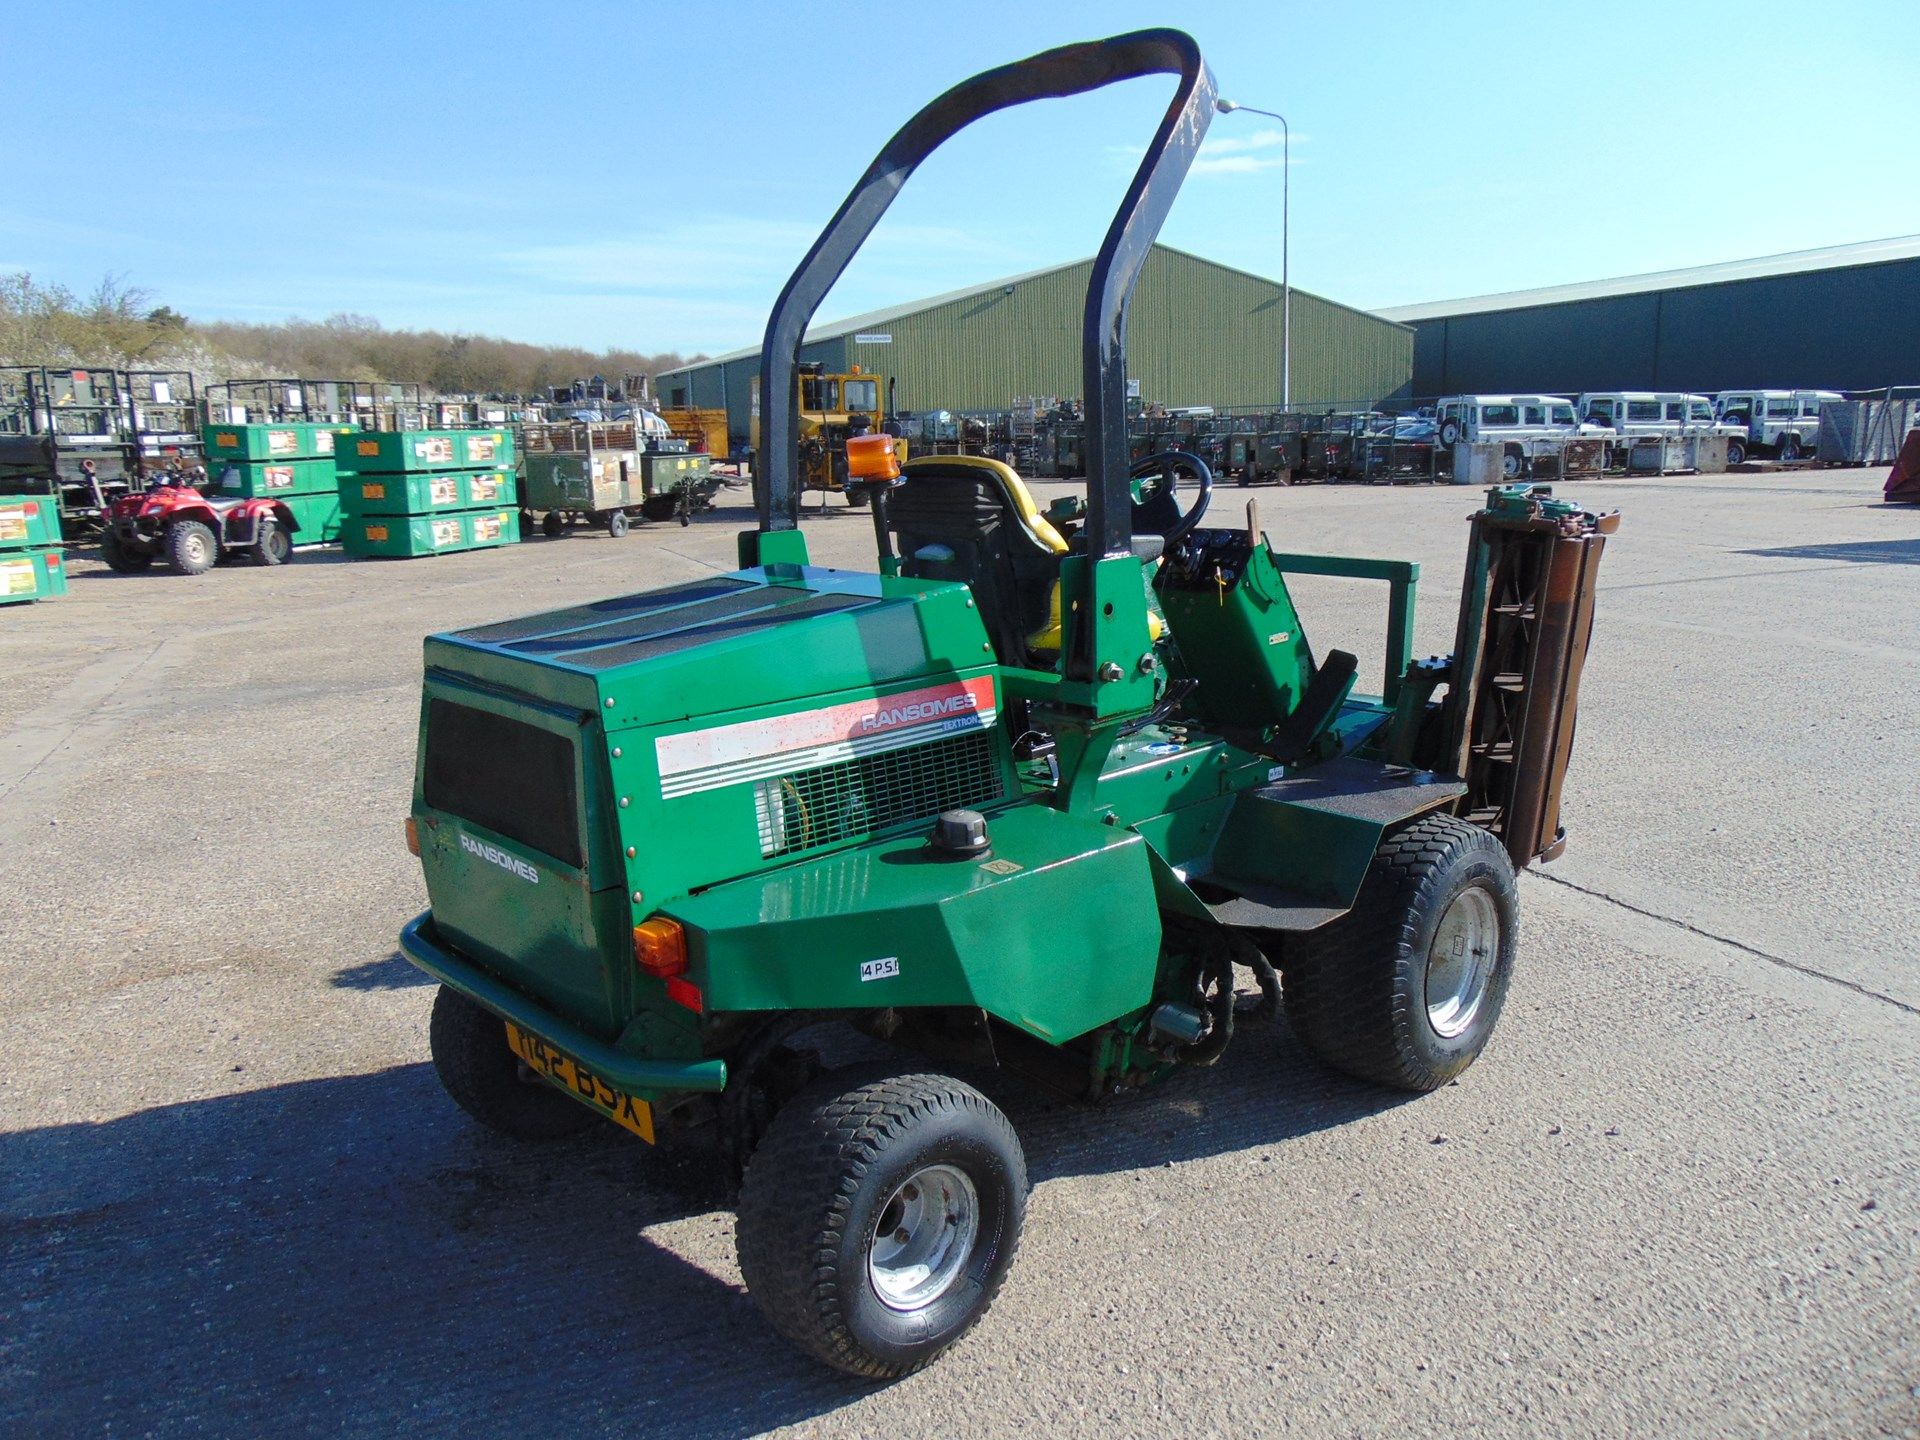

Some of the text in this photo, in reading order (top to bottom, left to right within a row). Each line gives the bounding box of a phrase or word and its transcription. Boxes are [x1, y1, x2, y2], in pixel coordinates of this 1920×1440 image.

[861, 692, 977, 730] RANSOMES
[943, 715, 978, 731] TEXTRON
[460, 834, 539, 884] RANSOMES
